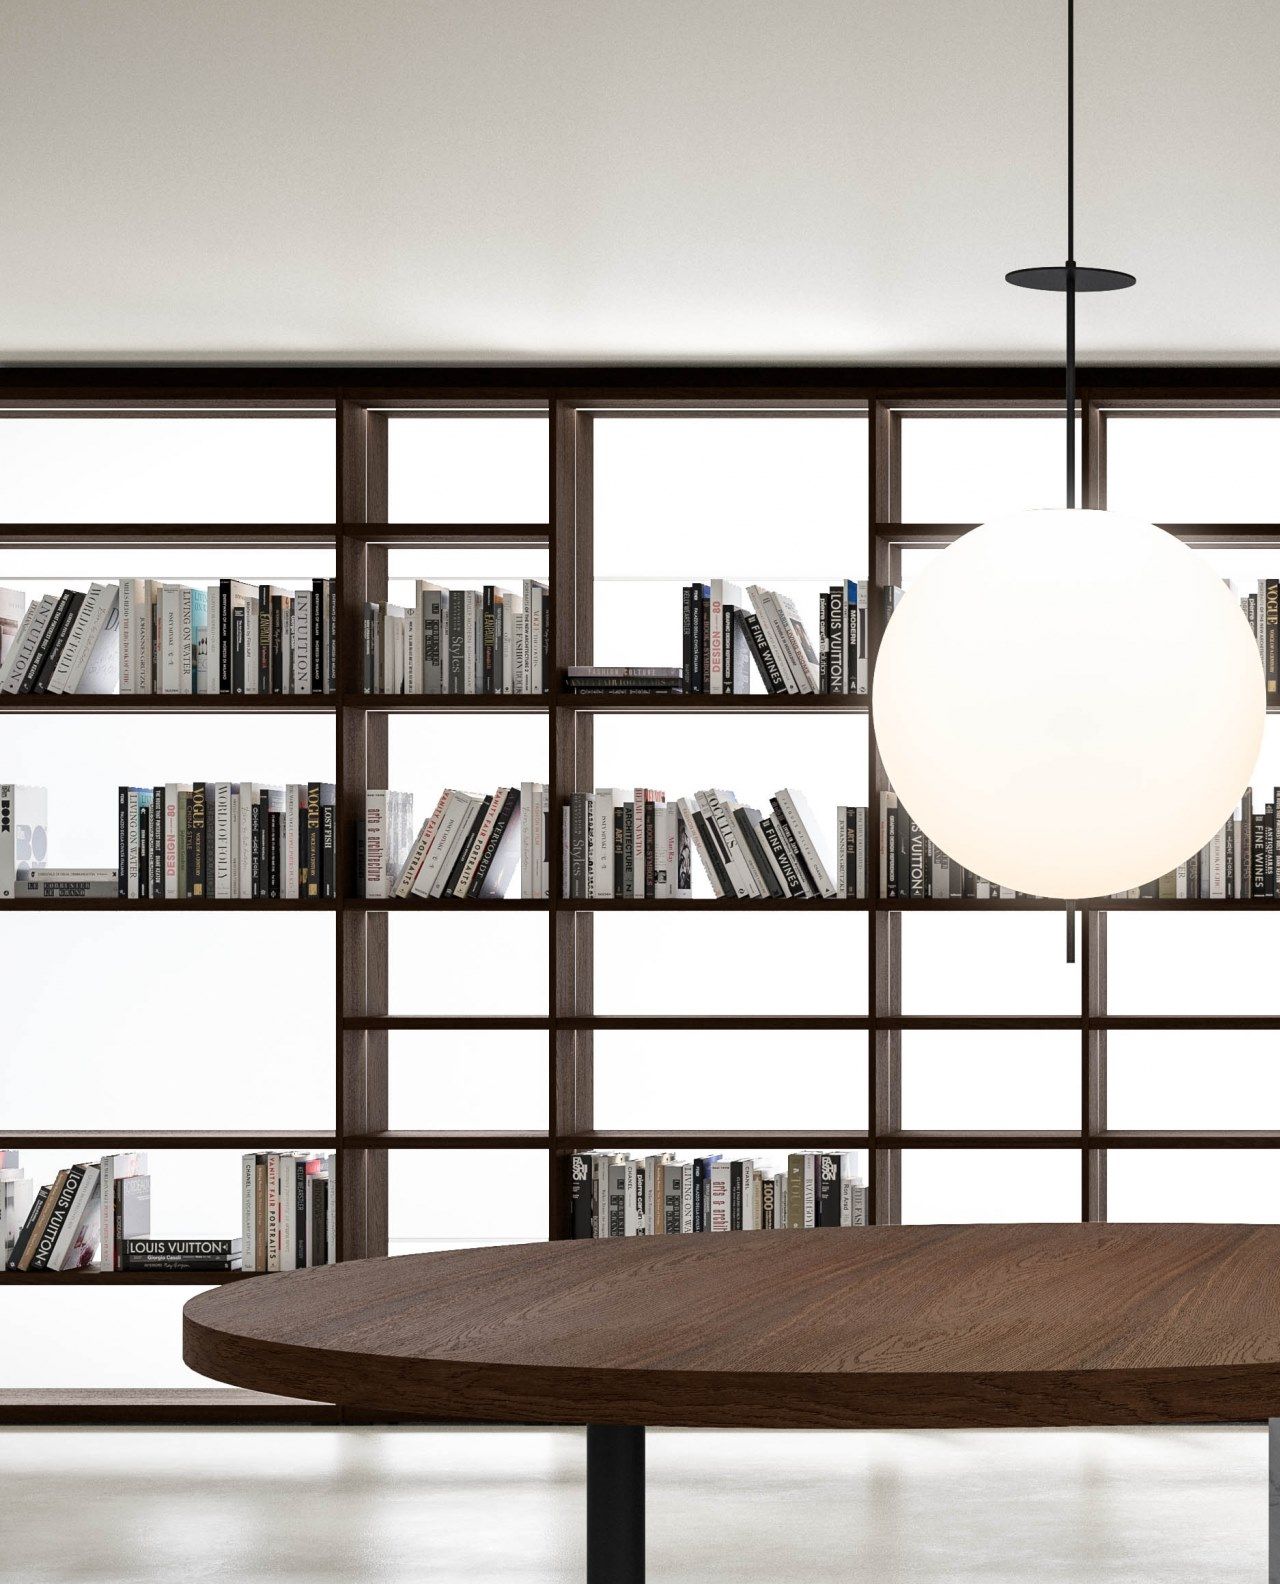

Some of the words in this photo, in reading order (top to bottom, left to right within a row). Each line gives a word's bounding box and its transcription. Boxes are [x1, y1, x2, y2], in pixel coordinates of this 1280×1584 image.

[183, 591, 191, 624] LIVING
[831, 594, 842, 629] LOUIS
[1267, 584, 1278, 625] VOGUE
[10, 600, 53, 681] INTUITION
[183, 627, 191, 641] ON
[298, 595, 308, 682] INTUITION
[515, 616, 523, 633] THE
[183, 644, 191, 675] WATER
[449, 636, 463, 673] Styles
[515, 634, 523, 669] FASHION
[751, 625, 767, 649] FINE
[762, 650, 782, 685] WINES
[831, 632, 842, 686] VUITTON
[193, 788, 204, 829] VOGUE
[218, 786, 227, 827] WORLD
[308, 788, 319, 829] VOGUE
[324, 807, 332, 828] LOST
[368, 809, 382, 823] arts
[435, 792, 449, 819] VANITY
[488, 791, 502, 818] VANITY
[130, 831, 137, 844] ON
[218, 829, 227, 844] OF
[324, 830, 332, 848] FISH
[424, 821, 436, 838] FAIR
[480, 820, 491, 837] FAIR
[708, 798, 737, 849] OCULUS
[1255, 826, 1263, 849] FINE
[167, 835, 175, 876] DESIGN
[218, 846, 227, 880] FOLLY
[368, 837, 383, 882] architecture
[403, 840, 427, 885] PORTRAITS
[461, 840, 483, 885] PORTRAITS
[477, 821, 505, 879] VERVOORDT
[570, 839, 585, 876] Styles
[766, 829, 782, 852] FINE
[779, 856, 799, 887] WINES
[911, 836, 922, 889] VUITTON
[1255, 853, 1263, 888] WINES
[58, 1173, 81, 1208] LOUIS
[636, 1175, 644, 1196] pierre
[713, 1182, 727, 1196] arts
[764, 1184, 773, 1210] 1000
[685, 1204, 691, 1217] ON
[35, 1210, 66, 1261] VUITTON
[130, 1242, 165, 1253] LOUIS
[168, 1242, 222, 1253] VUITTON
